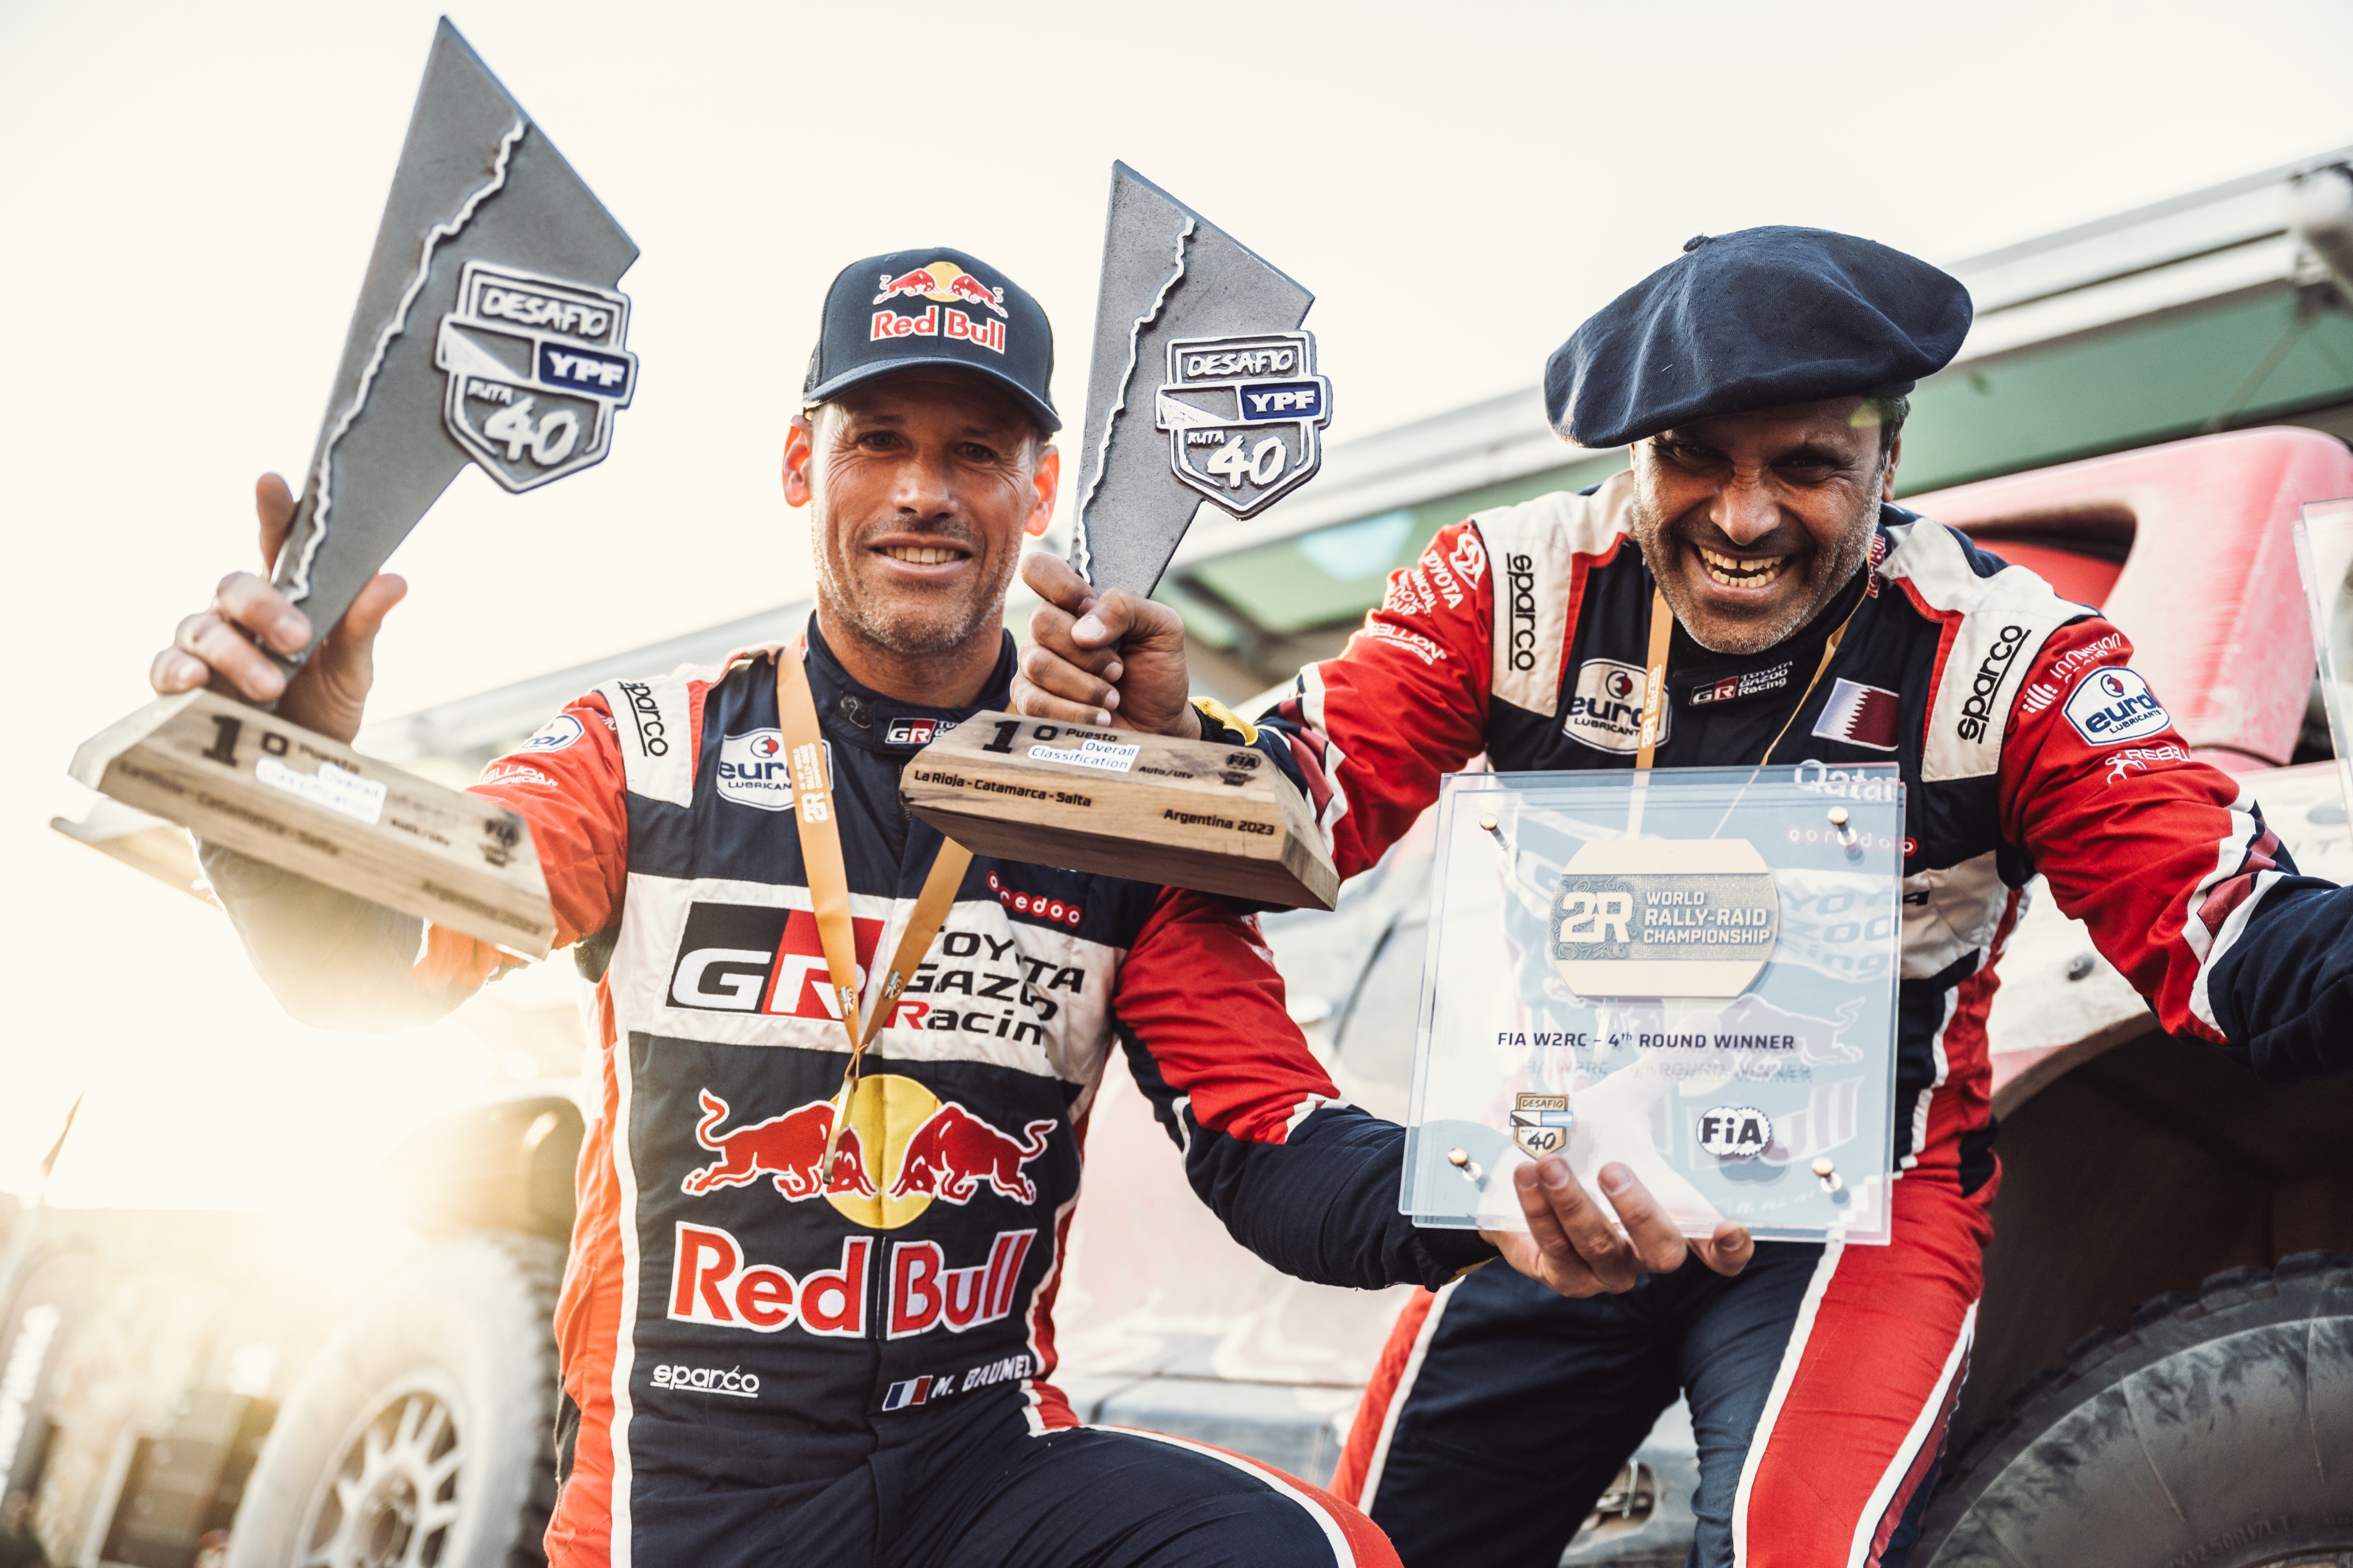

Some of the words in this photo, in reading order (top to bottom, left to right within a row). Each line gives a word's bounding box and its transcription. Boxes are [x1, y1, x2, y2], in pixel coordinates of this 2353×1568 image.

[870, 306, 939, 341] Red
[944, 307, 1005, 354] Bull
[547, 351, 625, 387] YPF
[1247, 391, 1315, 412] YPF
[484, 396, 579, 465] 40
[1187, 431, 1224, 444] RUTA
[1207, 435, 1286, 488] 40
[1507, 554, 1536, 671] sparco
[1739, 669, 1788, 688] GAZOO
[1740, 661, 1793, 681] TOYOTA
[1738, 677, 1787, 697] Racing
[1957, 625, 2023, 740] sparco
[1693, 685, 1734, 703] GR
[1568, 696, 1644, 728] euro
[2086, 688, 2161, 732] eurol
[1574, 718, 1640, 736] LUBRICANT
[2109, 710, 2162, 733] LUBRICANTS
[889, 728, 930, 741] GR
[1066, 728, 1117, 743] Puesto
[1032, 748, 1128, 769] Classification
[1085, 742, 1135, 756] Overall
[719, 761, 792, 779] eur
[728, 781, 792, 790] LUBRICAN
[915, 770, 929, 781] La
[932, 773, 965, 787] Rioja
[974, 779, 1046, 800] Catamarca
[1055, 791, 1091, 807] Salta
[1164, 809, 1233, 829] Argentina
[1237, 820, 1275, 836] 2023
[1646, 891, 1704, 906] WORLD
[1560, 893, 1633, 943] 2R
[1645, 908, 1767, 926] RALLY-RAID
[1643, 929, 1770, 944] CHAMPIONSHIP
[673, 948, 866, 1019] GR
[883, 1001, 1043, 1045] Racin
[1498, 1032, 1526, 1046] FIA
[1533, 1033, 1587, 1046] W2RC
[1608, 1032, 1633, 1047] 4th
[1639, 1034, 1707, 1048] ROUND
[1714, 1034, 1795, 1049] WINNER
[1522, 1099, 1564, 1109] DESAFIO
[1527, 1131, 1556, 1150] 40
[668, 1222, 873, 1338] Red
[888, 1229, 1036, 1340] Bull
[651, 1364, 760, 1395] sparco
[931, 1374, 955, 1399] M.
[961, 1354, 1032, 1392] BAUMEL
